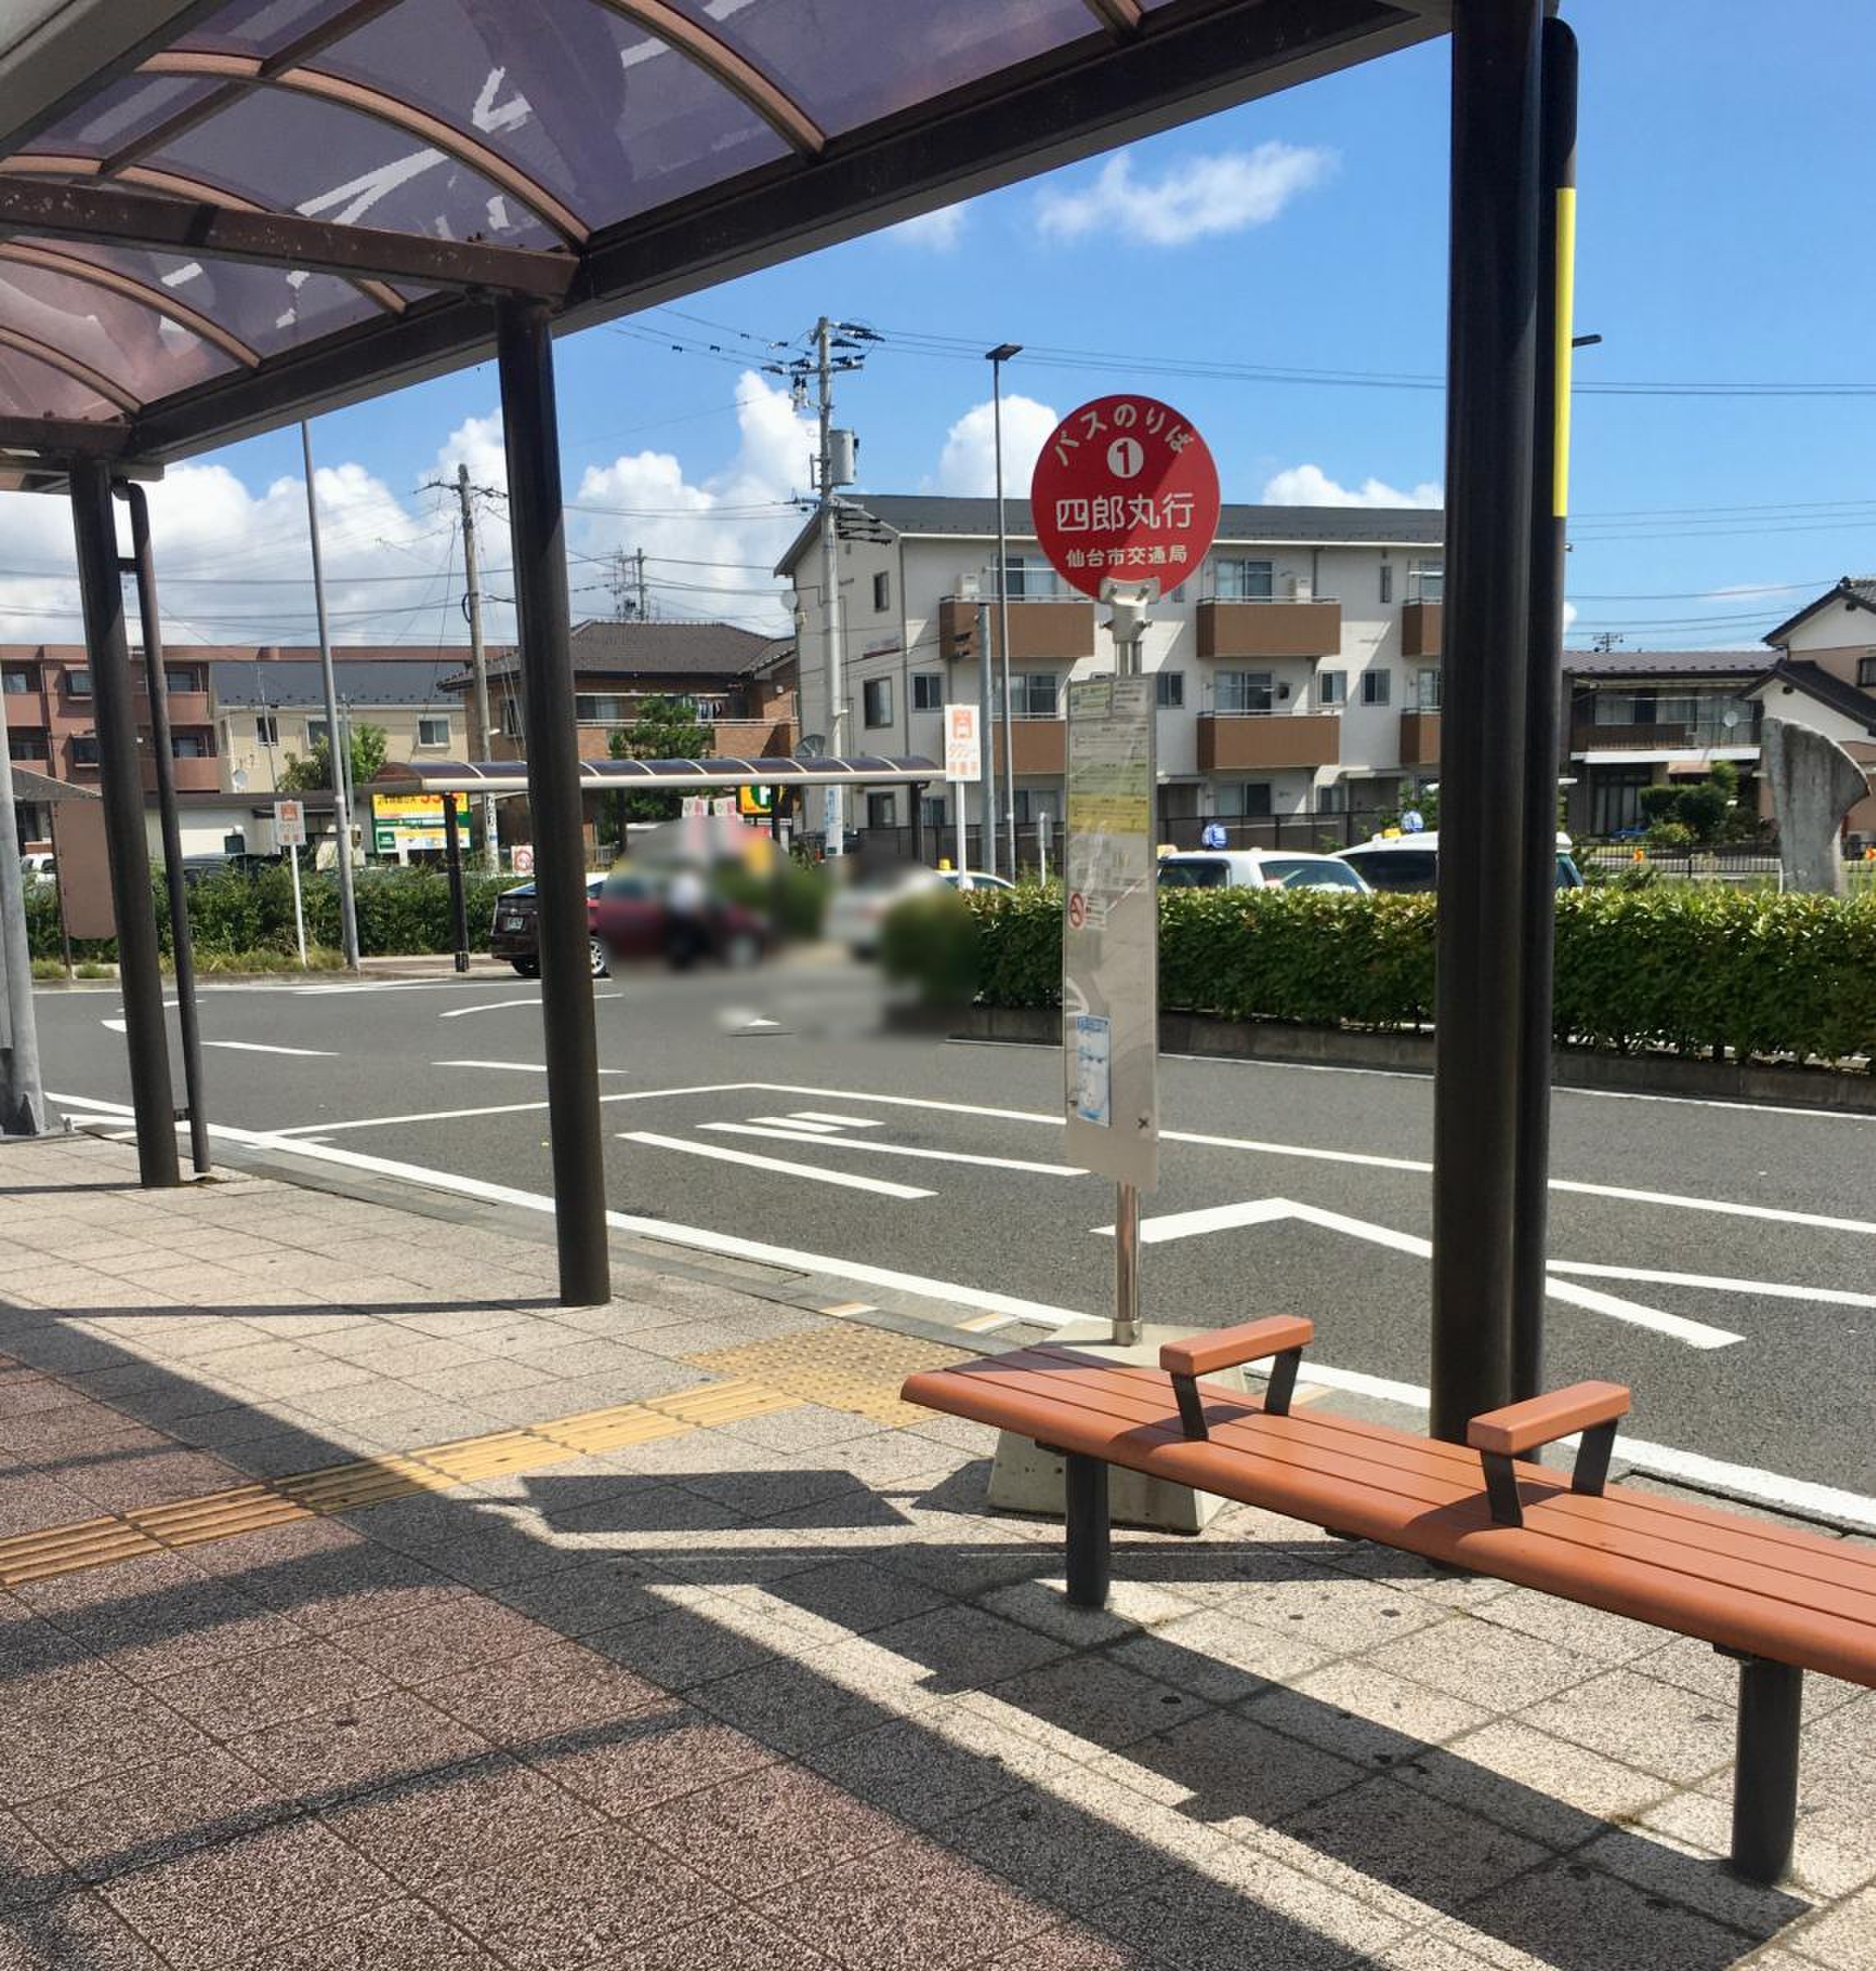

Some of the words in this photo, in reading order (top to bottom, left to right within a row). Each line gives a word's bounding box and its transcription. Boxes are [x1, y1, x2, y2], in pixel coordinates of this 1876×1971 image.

[1055, 403, 1193, 466] バスのりば
[1056, 493, 1194, 532] 四郎丸行
[1065, 544, 1188, 567] 仙台市交通局
